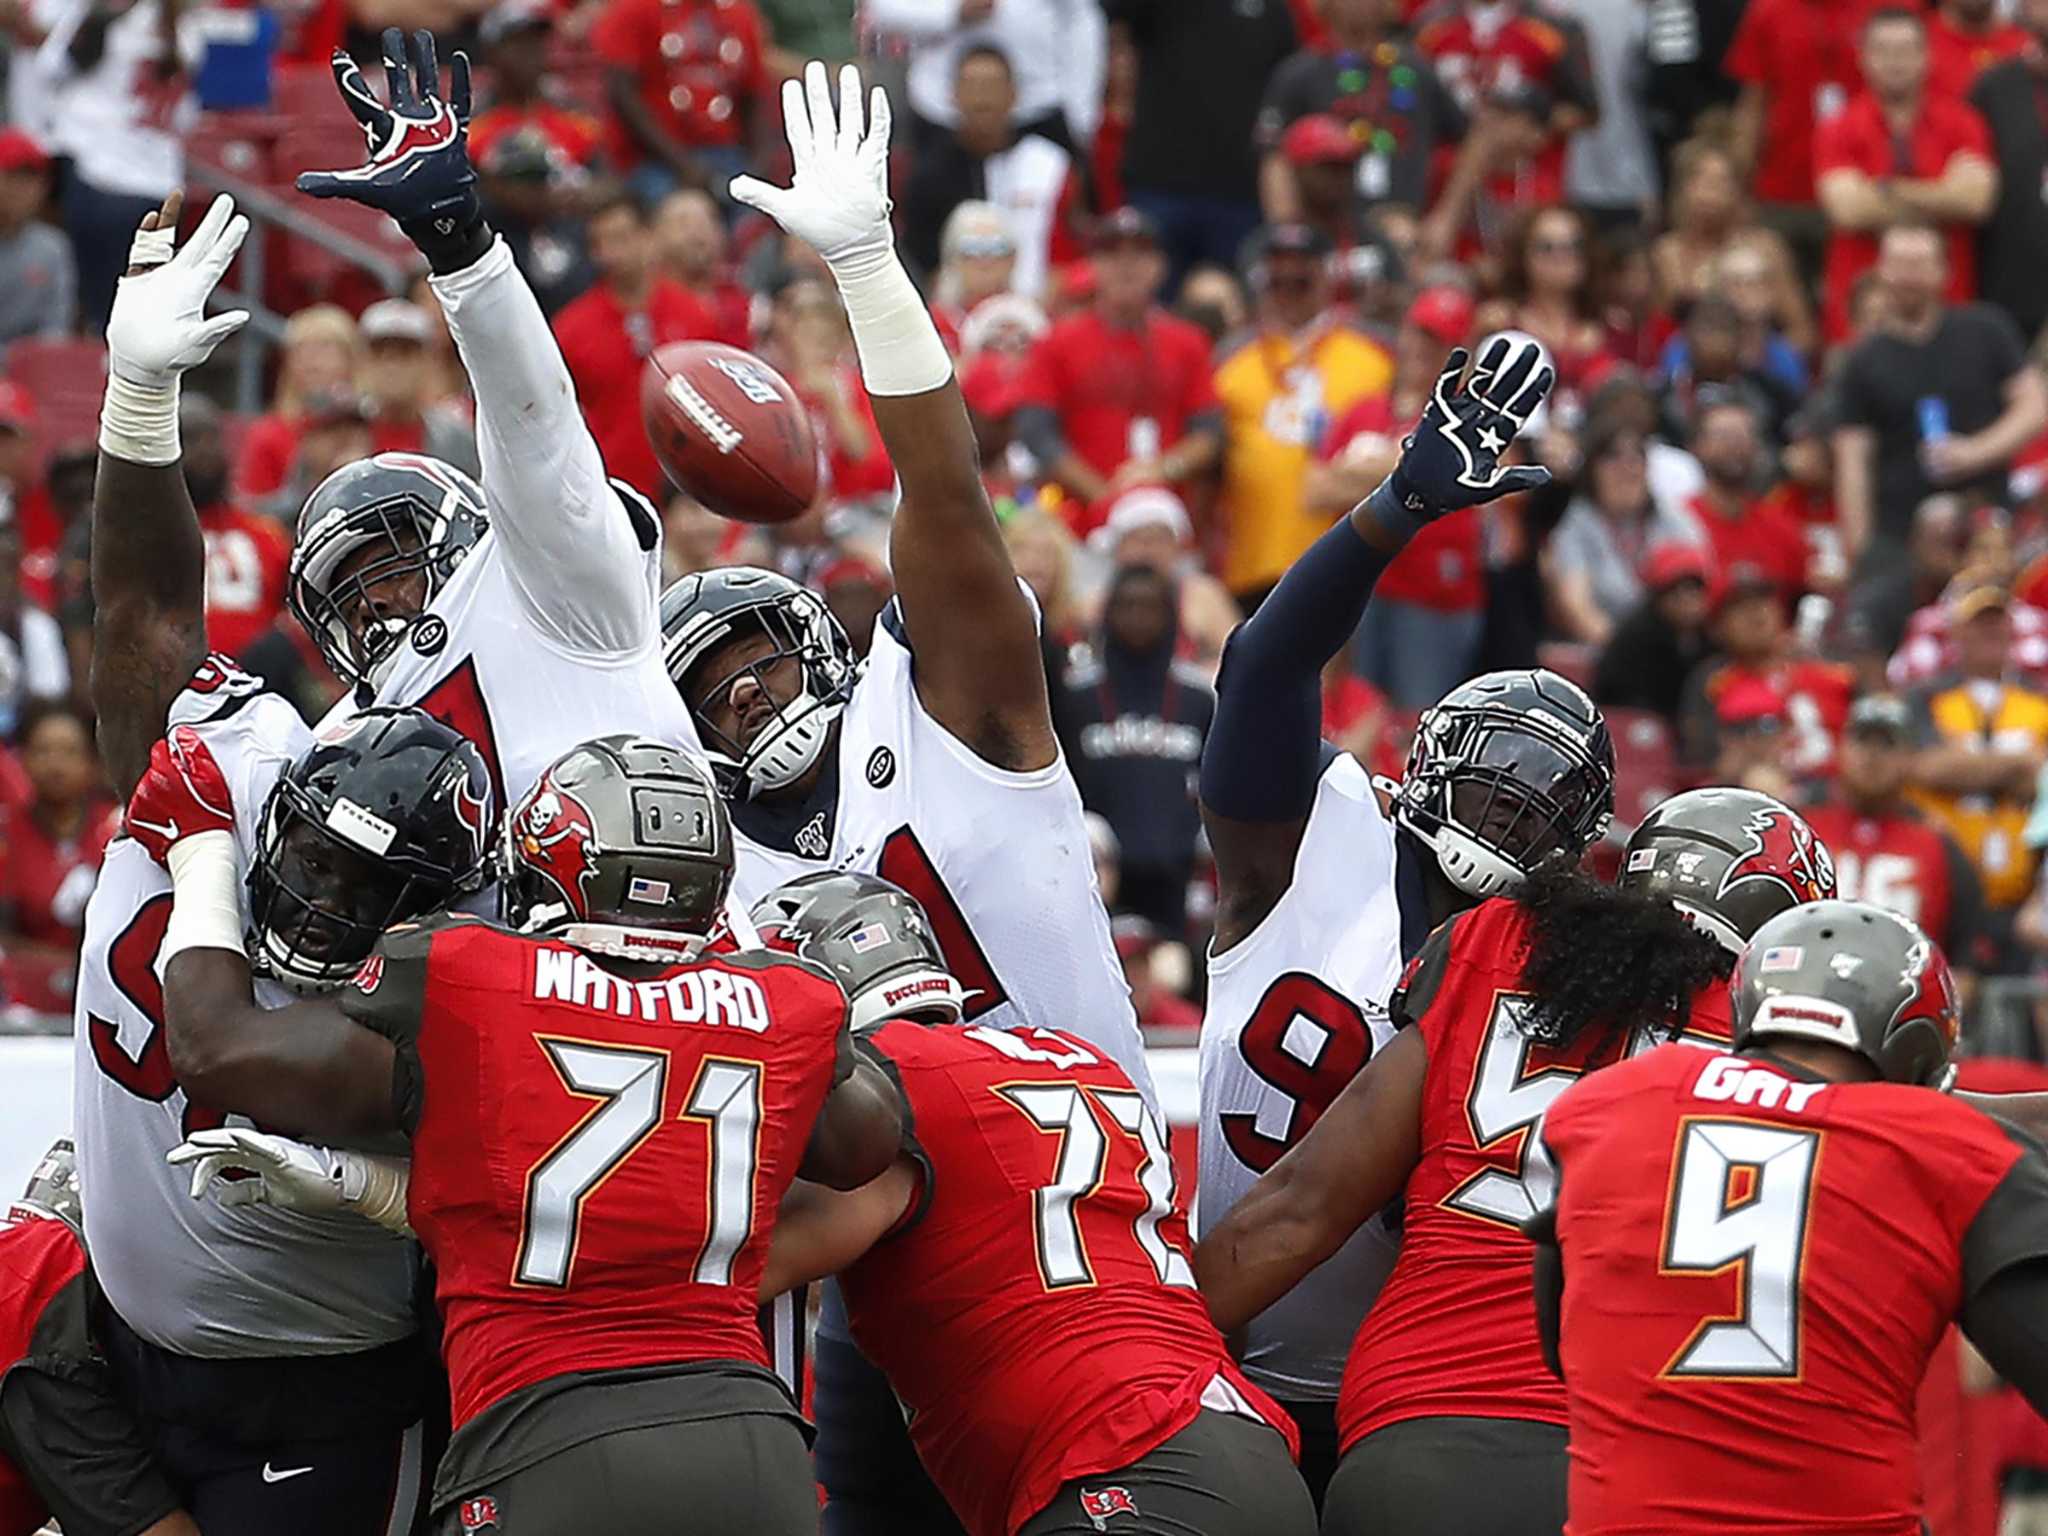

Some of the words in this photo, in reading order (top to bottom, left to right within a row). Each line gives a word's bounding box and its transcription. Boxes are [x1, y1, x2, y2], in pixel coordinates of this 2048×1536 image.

[534, 948, 770, 1033] WATFORD
[511, 1032, 765, 1290] 71
[1693, 1055, 1827, 1113] GAY
[1656, 1114, 1824, 1383] 9
